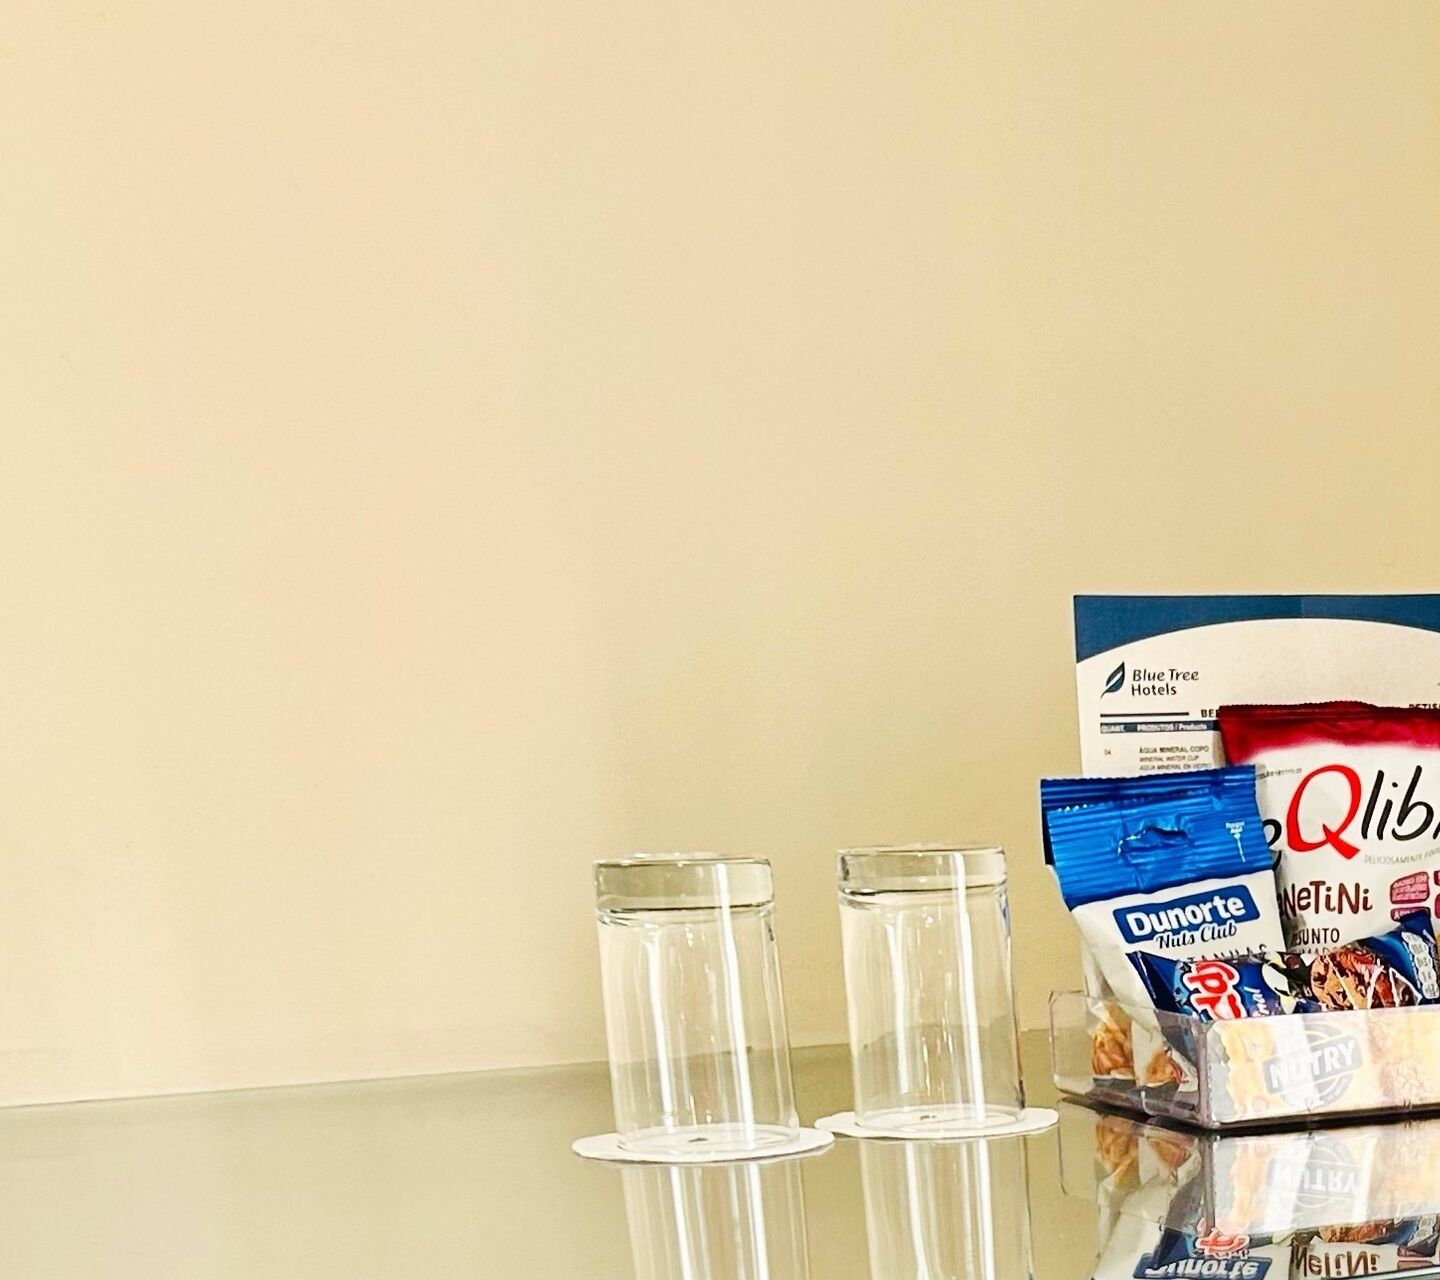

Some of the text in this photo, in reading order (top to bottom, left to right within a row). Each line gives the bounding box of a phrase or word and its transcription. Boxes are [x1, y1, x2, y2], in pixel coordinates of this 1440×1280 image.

[1133, 669, 1200, 682] Blue Tree
[1131, 683, 1177, 697] Hotels
[1125, 895, 1247, 938] Dunorte
[1156, 922, 1238, 949] Nuts Club
[1269, 1039, 1355, 1087] NUTRY
